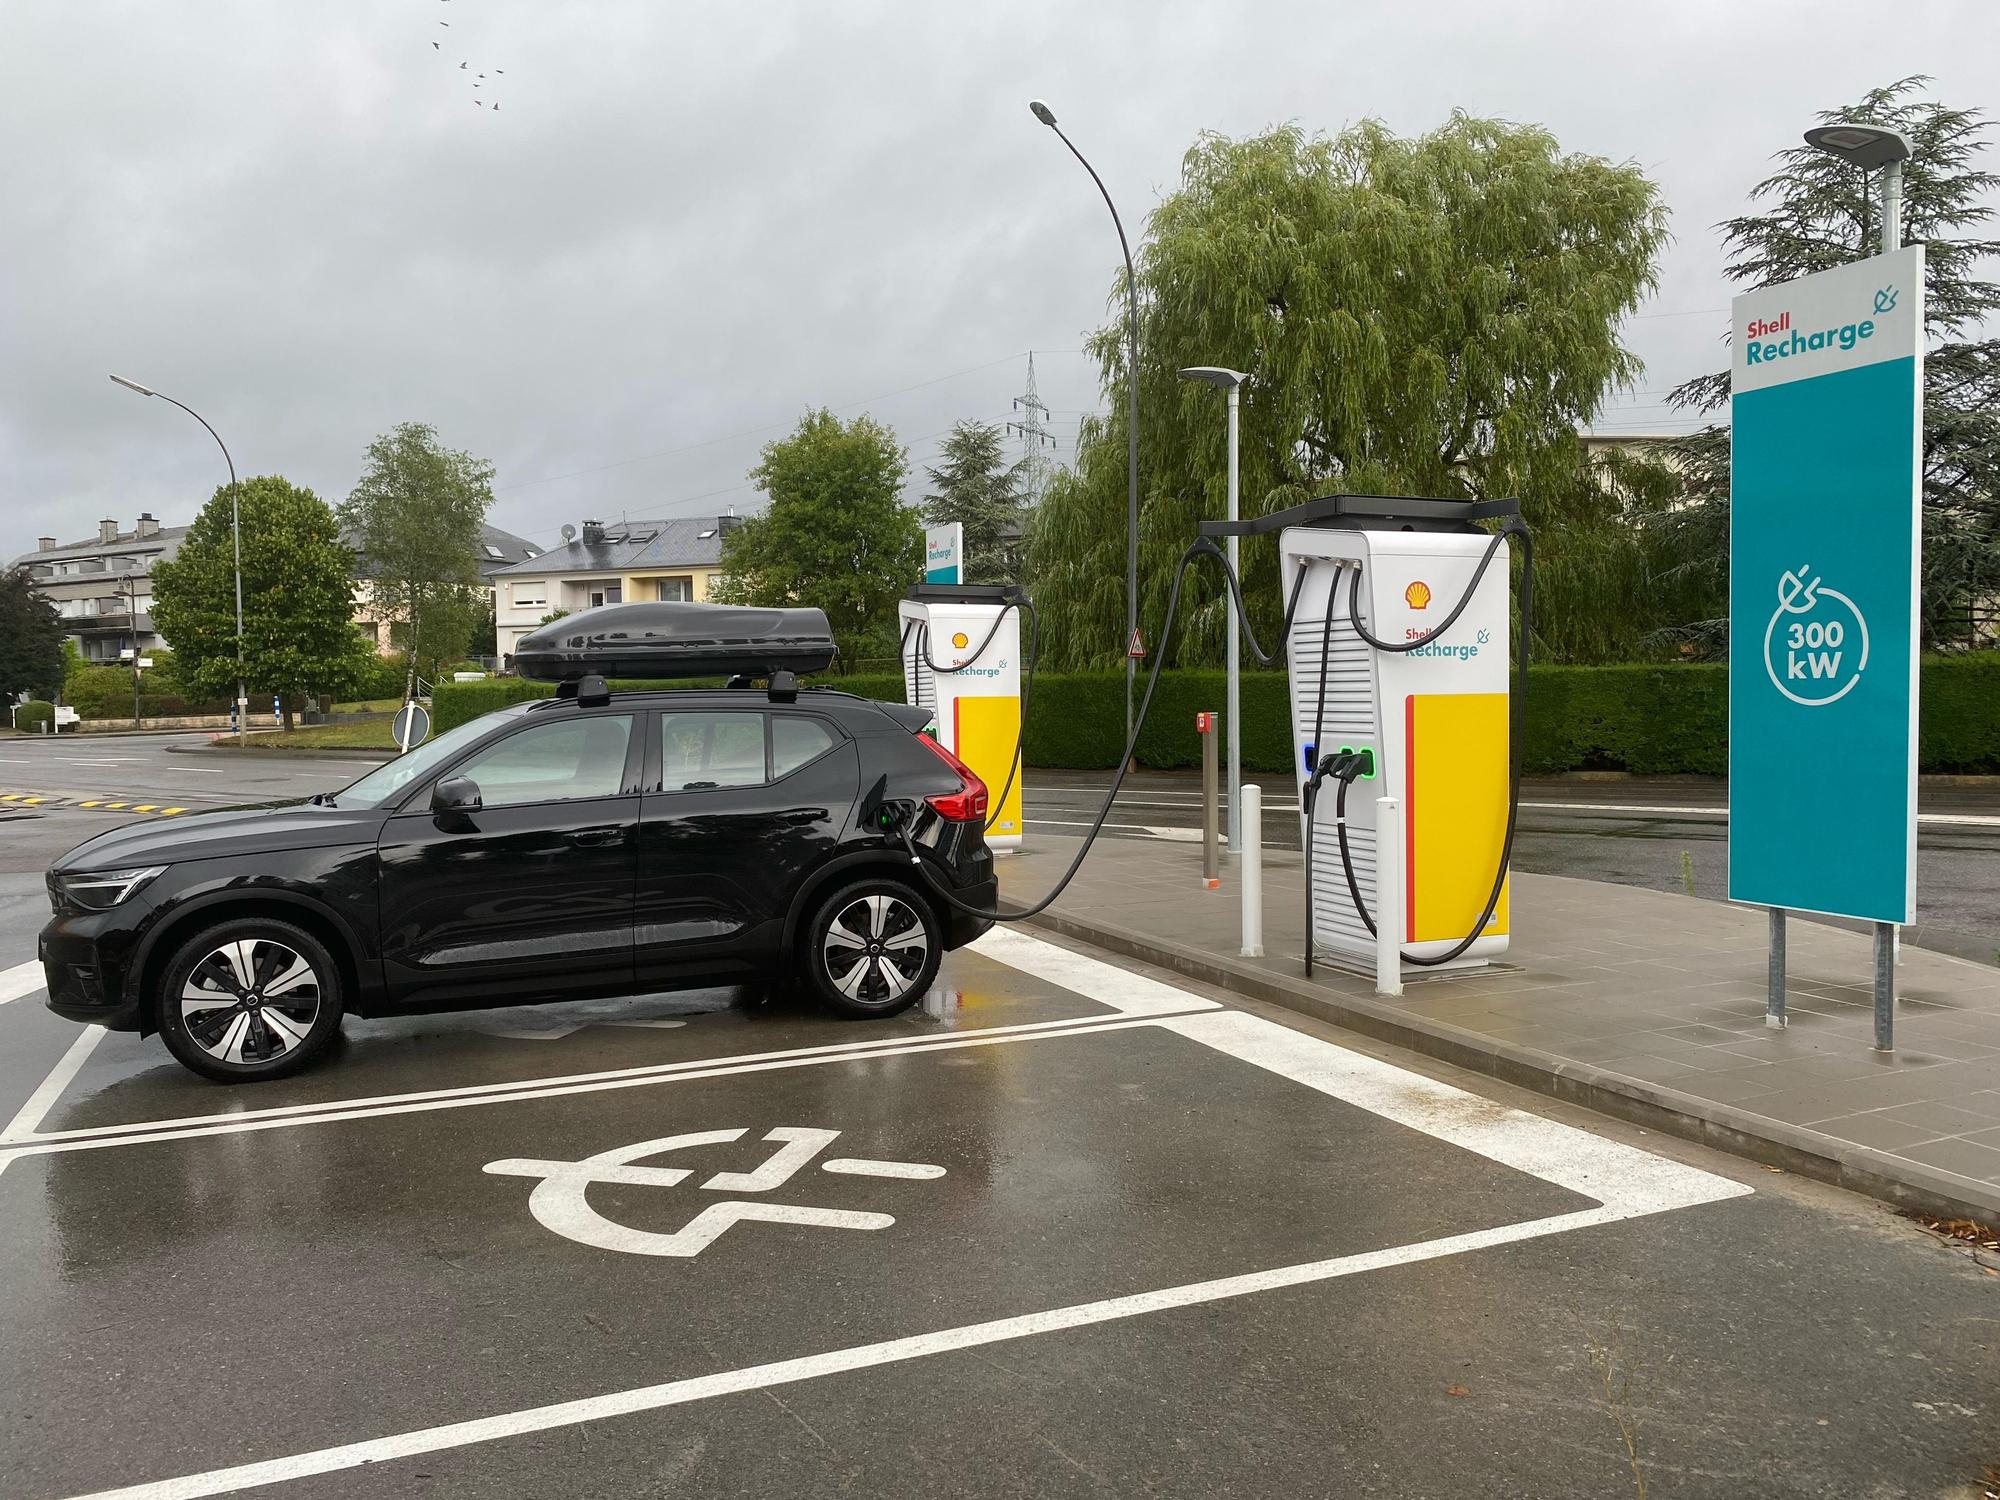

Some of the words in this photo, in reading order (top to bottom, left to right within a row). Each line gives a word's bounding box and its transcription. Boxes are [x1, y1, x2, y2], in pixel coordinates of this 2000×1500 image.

[1748, 312, 1790, 339] Shell
[1747, 320, 1874, 365] Recharge
[1788, 621, 1844, 649] 300
[1788, 651, 1843, 679] kW
